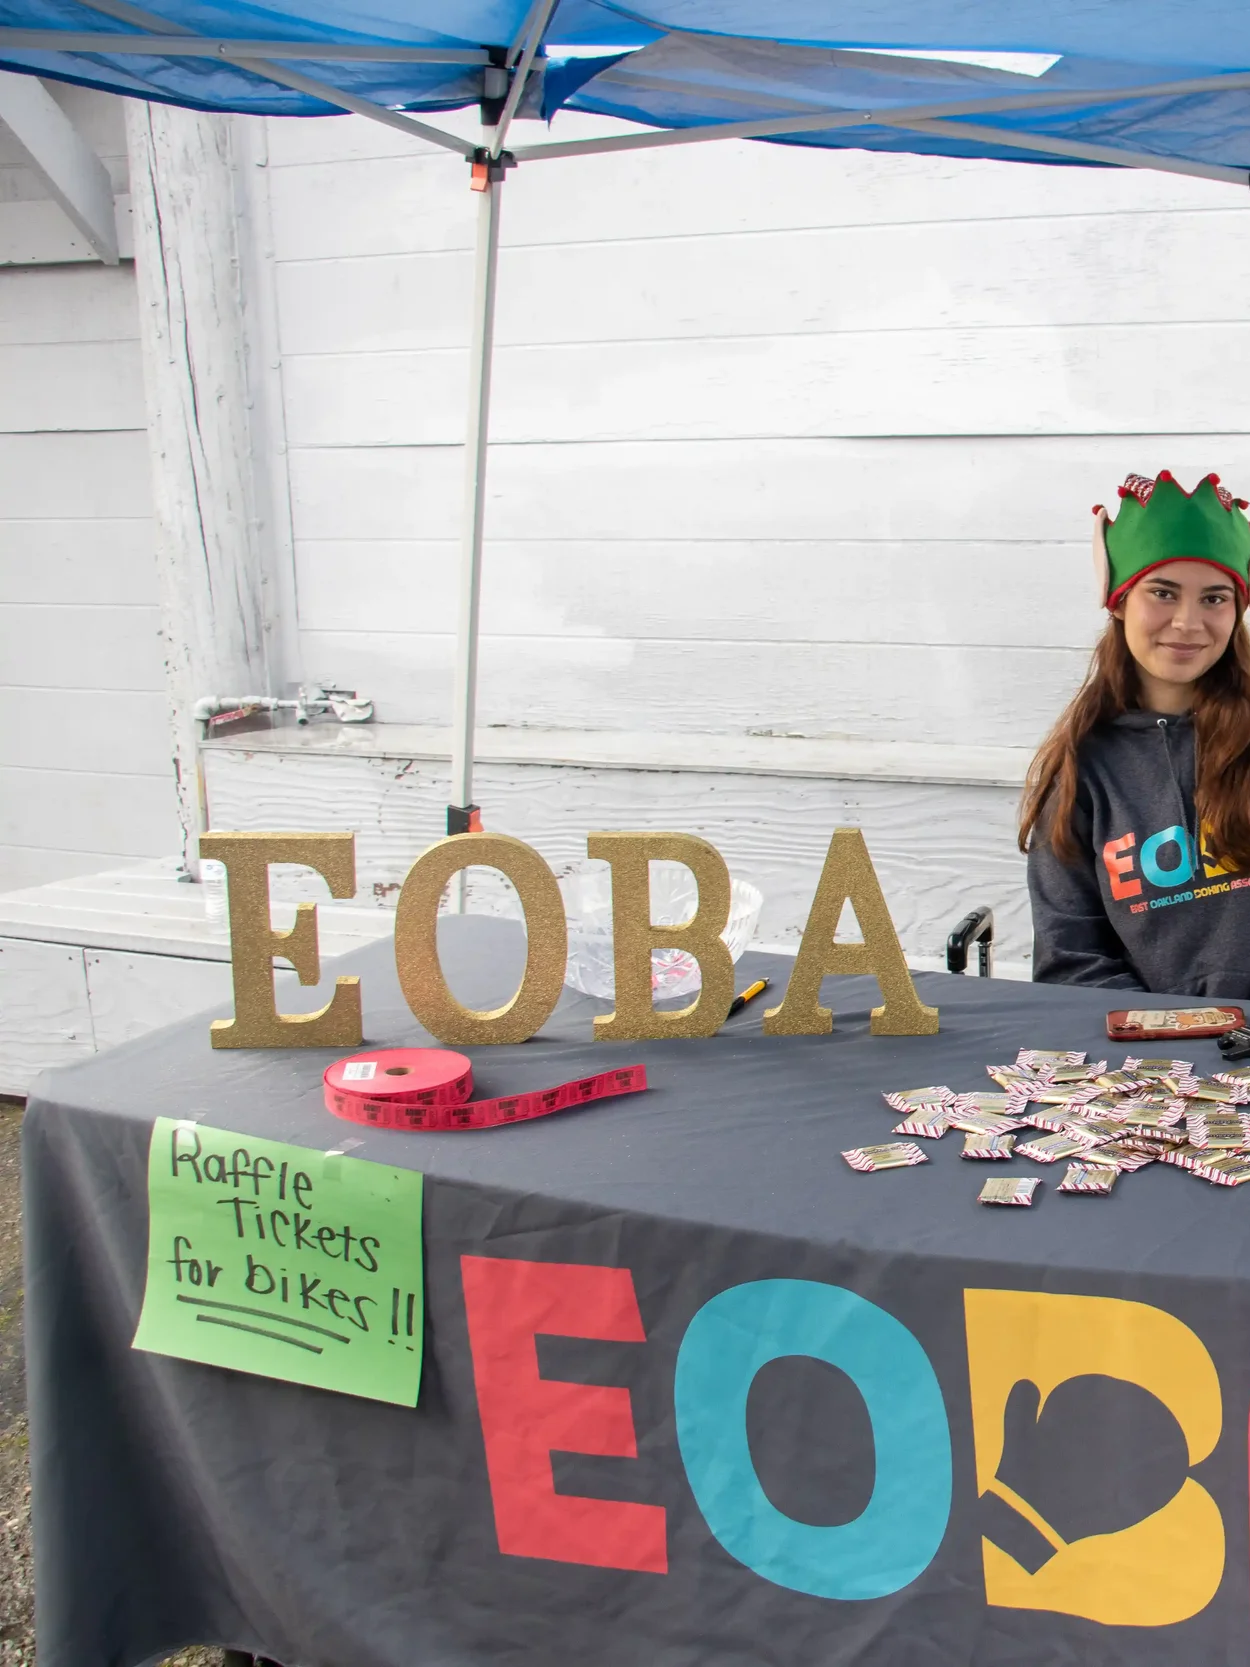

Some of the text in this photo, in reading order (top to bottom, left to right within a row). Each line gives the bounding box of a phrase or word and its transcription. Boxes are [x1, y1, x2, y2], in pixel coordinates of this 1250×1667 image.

[1129, 901, 1149, 914] EAST
[1150, 891, 1194, 909] OAKLAND
[1193, 882, 1231, 899] BOXING
[199, 827, 940, 1049] EOBA
[171, 1128, 313, 1209] Raffle
[166, 1235, 222, 1289] for
[216, 1196, 381, 1274] Tickets
